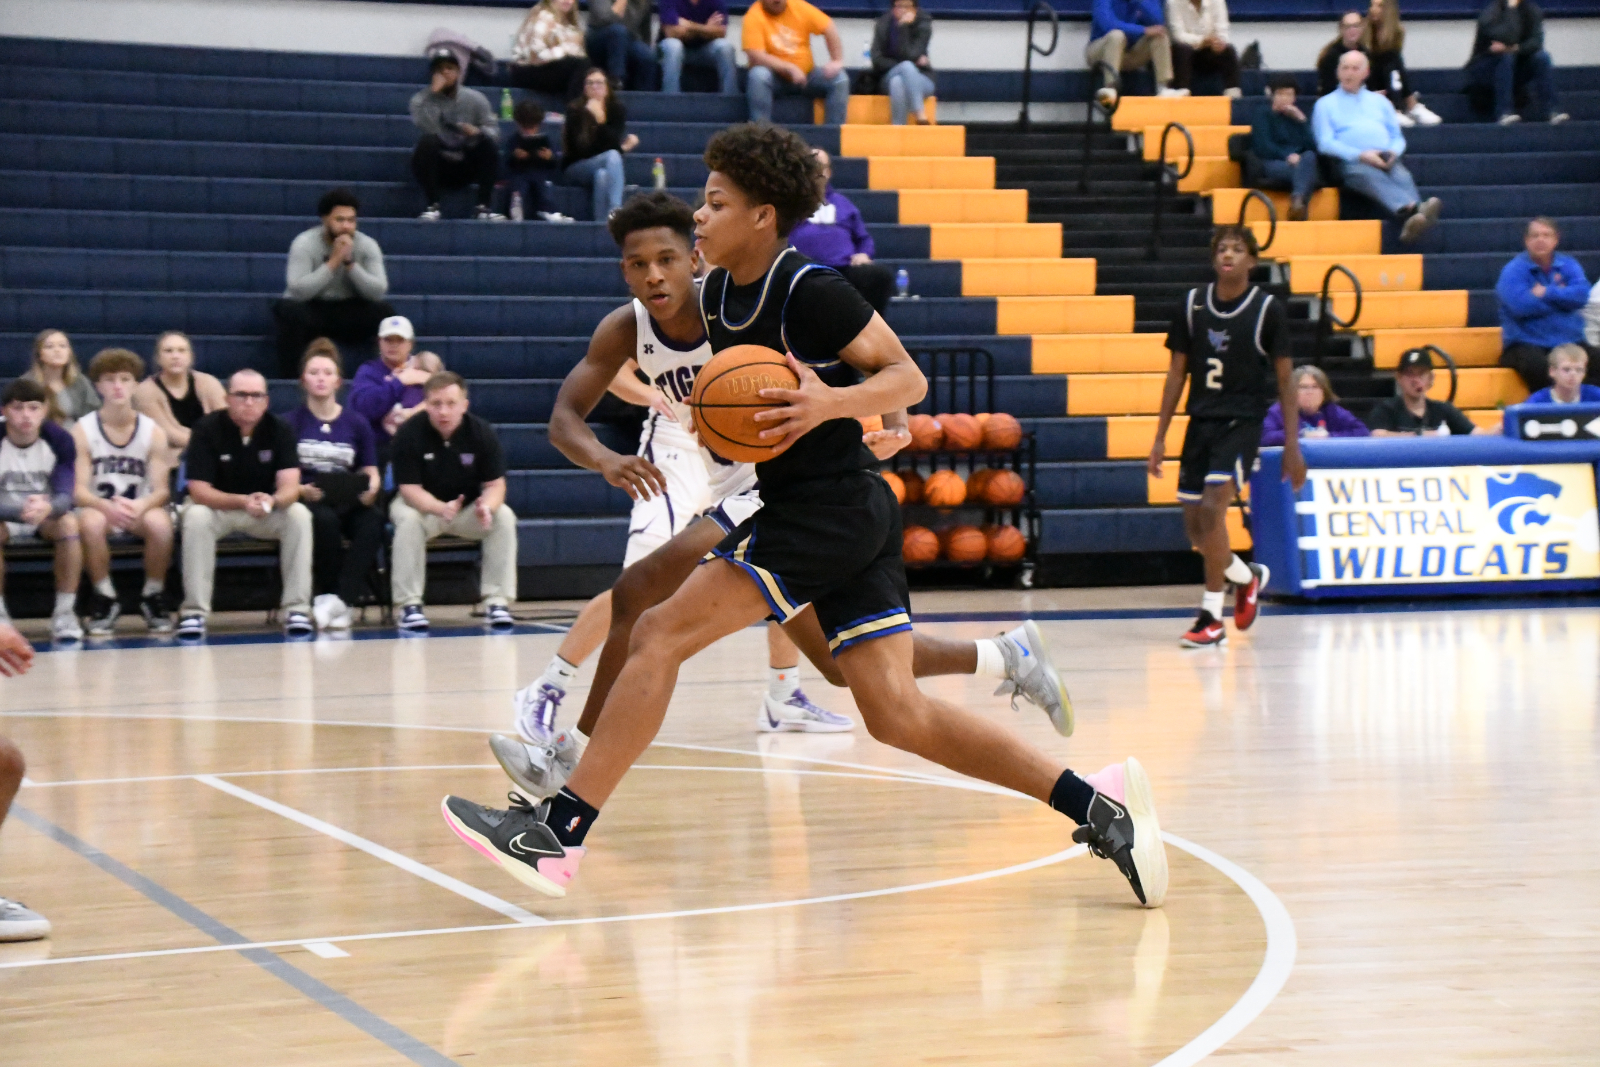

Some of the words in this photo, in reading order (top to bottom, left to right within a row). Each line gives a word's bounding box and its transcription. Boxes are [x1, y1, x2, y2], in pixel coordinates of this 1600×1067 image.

[1205, 358, 1223, 390] 2
[1325, 476, 1471, 504] WILSON
[1328, 510, 1474, 537] CENTRAL
[1331, 542, 1570, 580] WILDCATS
